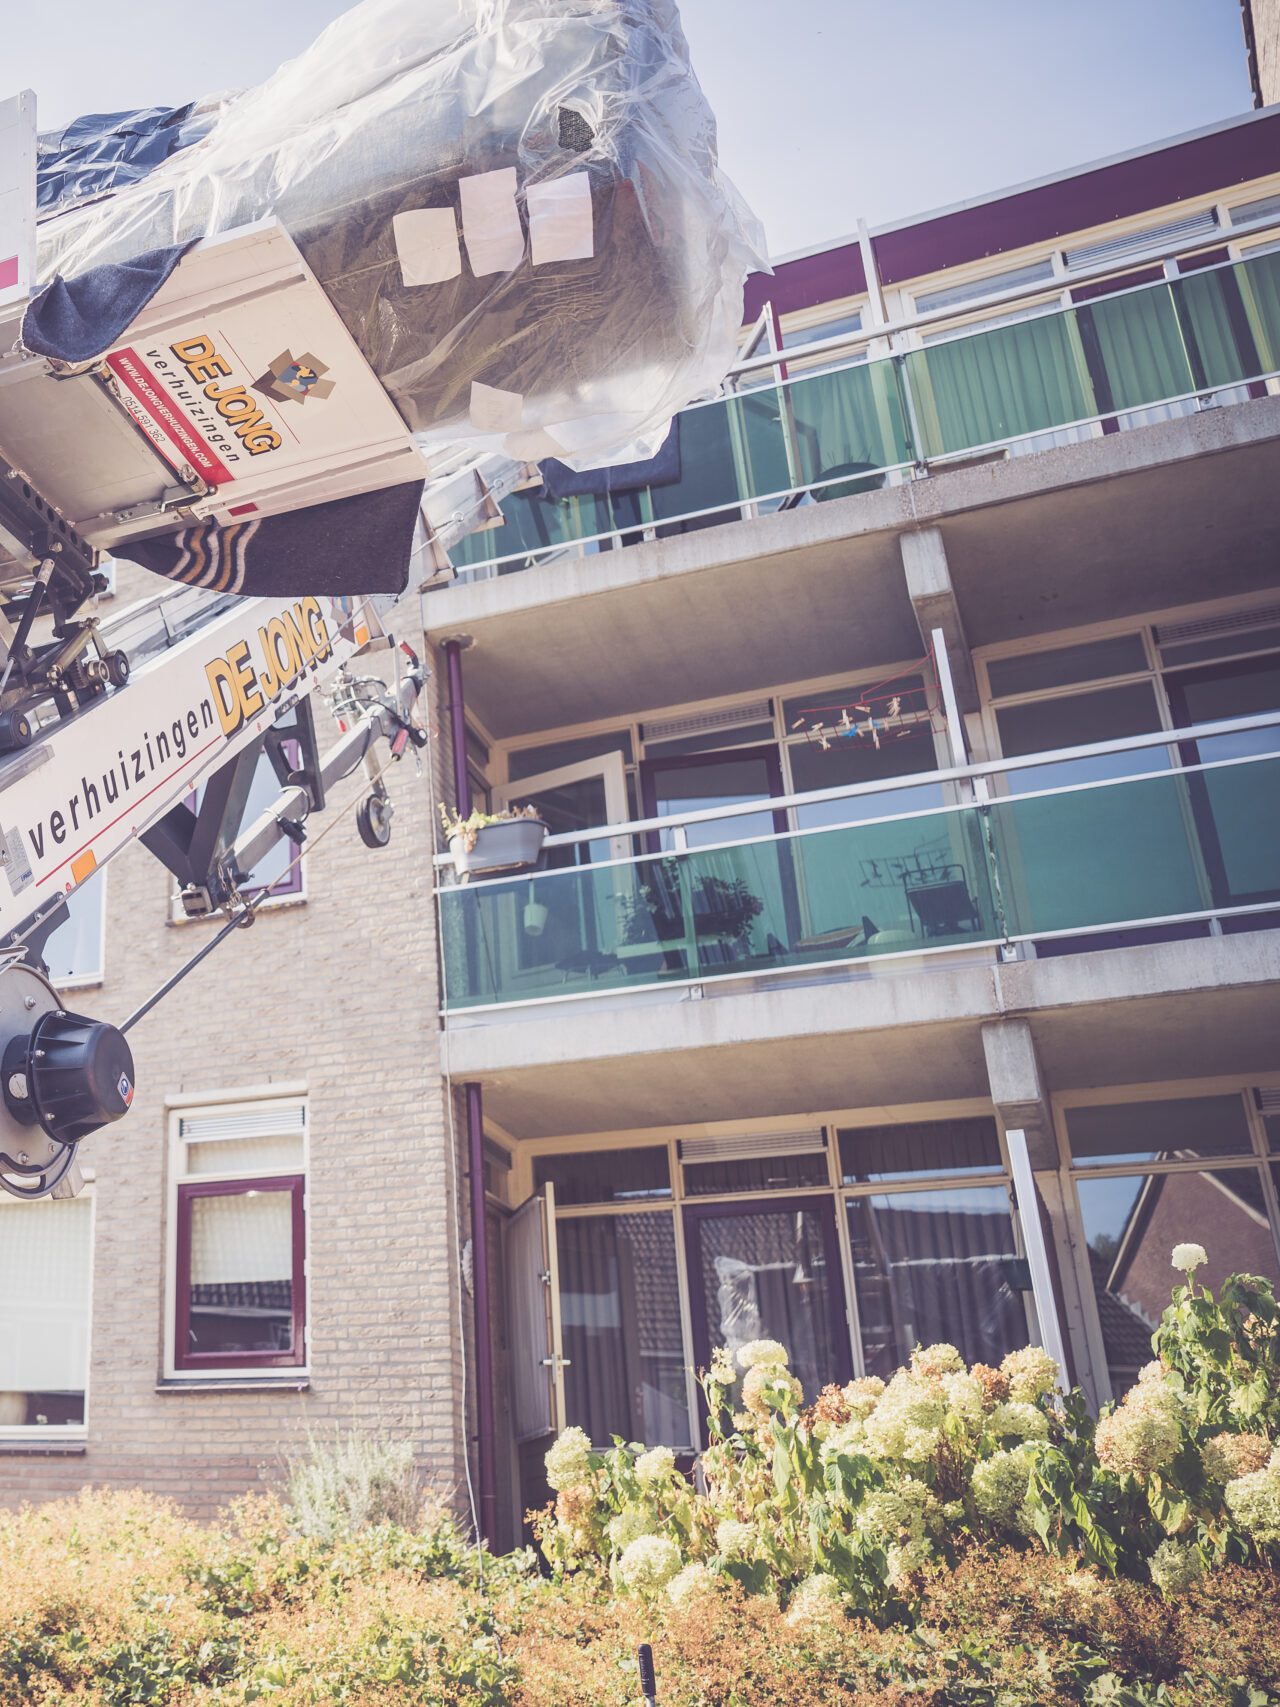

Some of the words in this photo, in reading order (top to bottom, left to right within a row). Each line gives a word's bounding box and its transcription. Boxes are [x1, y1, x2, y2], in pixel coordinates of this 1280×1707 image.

[118, 357, 214, 469] WWW.DEJONGVERHUIZINGEN.COM
[138, 415, 153, 428] 591
[149, 428, 166, 443] 362
[146, 349, 240, 462] verhuizingen
[168, 334, 233, 385] DE
[203, 381, 282, 457] JONG
[204, 639, 265, 740] DE
[257, 596, 334, 704] JONG
[28, 698, 214, 860] verhuizingen
